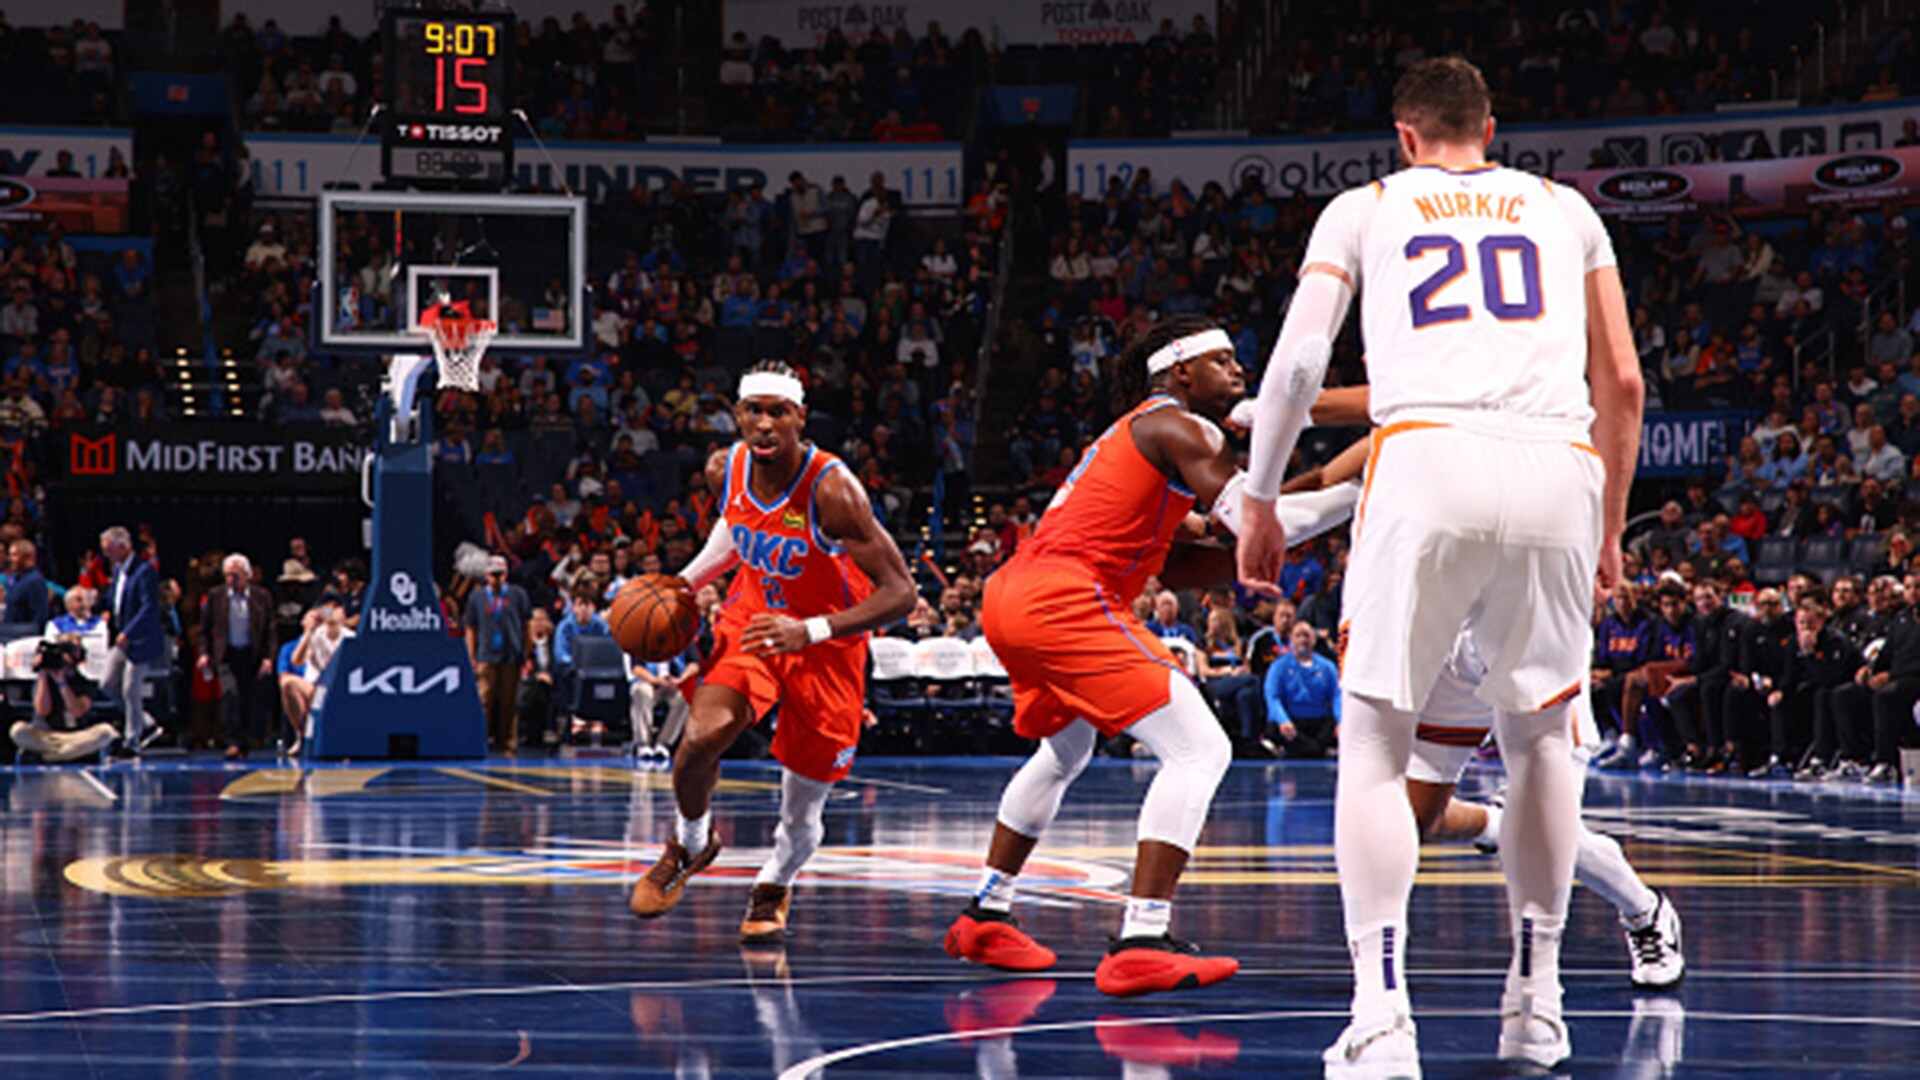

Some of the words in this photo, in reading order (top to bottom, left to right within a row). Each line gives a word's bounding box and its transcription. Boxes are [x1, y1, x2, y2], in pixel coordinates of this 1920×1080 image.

[798, 6, 843, 30] POST
[872, 5, 907, 28] OAK
[1041, 2, 1086, 25] POST
[1116, 0, 1152, 23] OAK
[424, 22, 496, 57] 9:07
[1056, 27, 1137, 44] TOYOTA
[434, 56, 489, 114] 15
[424, 124, 502, 143] TISSOT
[903, 167, 955, 199] 111
[1413, 192, 1525, 224] NURKIĆ
[1404, 235, 1545, 331] 20
[294, 441, 371, 472] BAN
[732, 524, 808, 579] OKC
[762, 576, 787, 609] 2
[370, 605, 441, 632] Health
[348, 665, 461, 694] KIA
